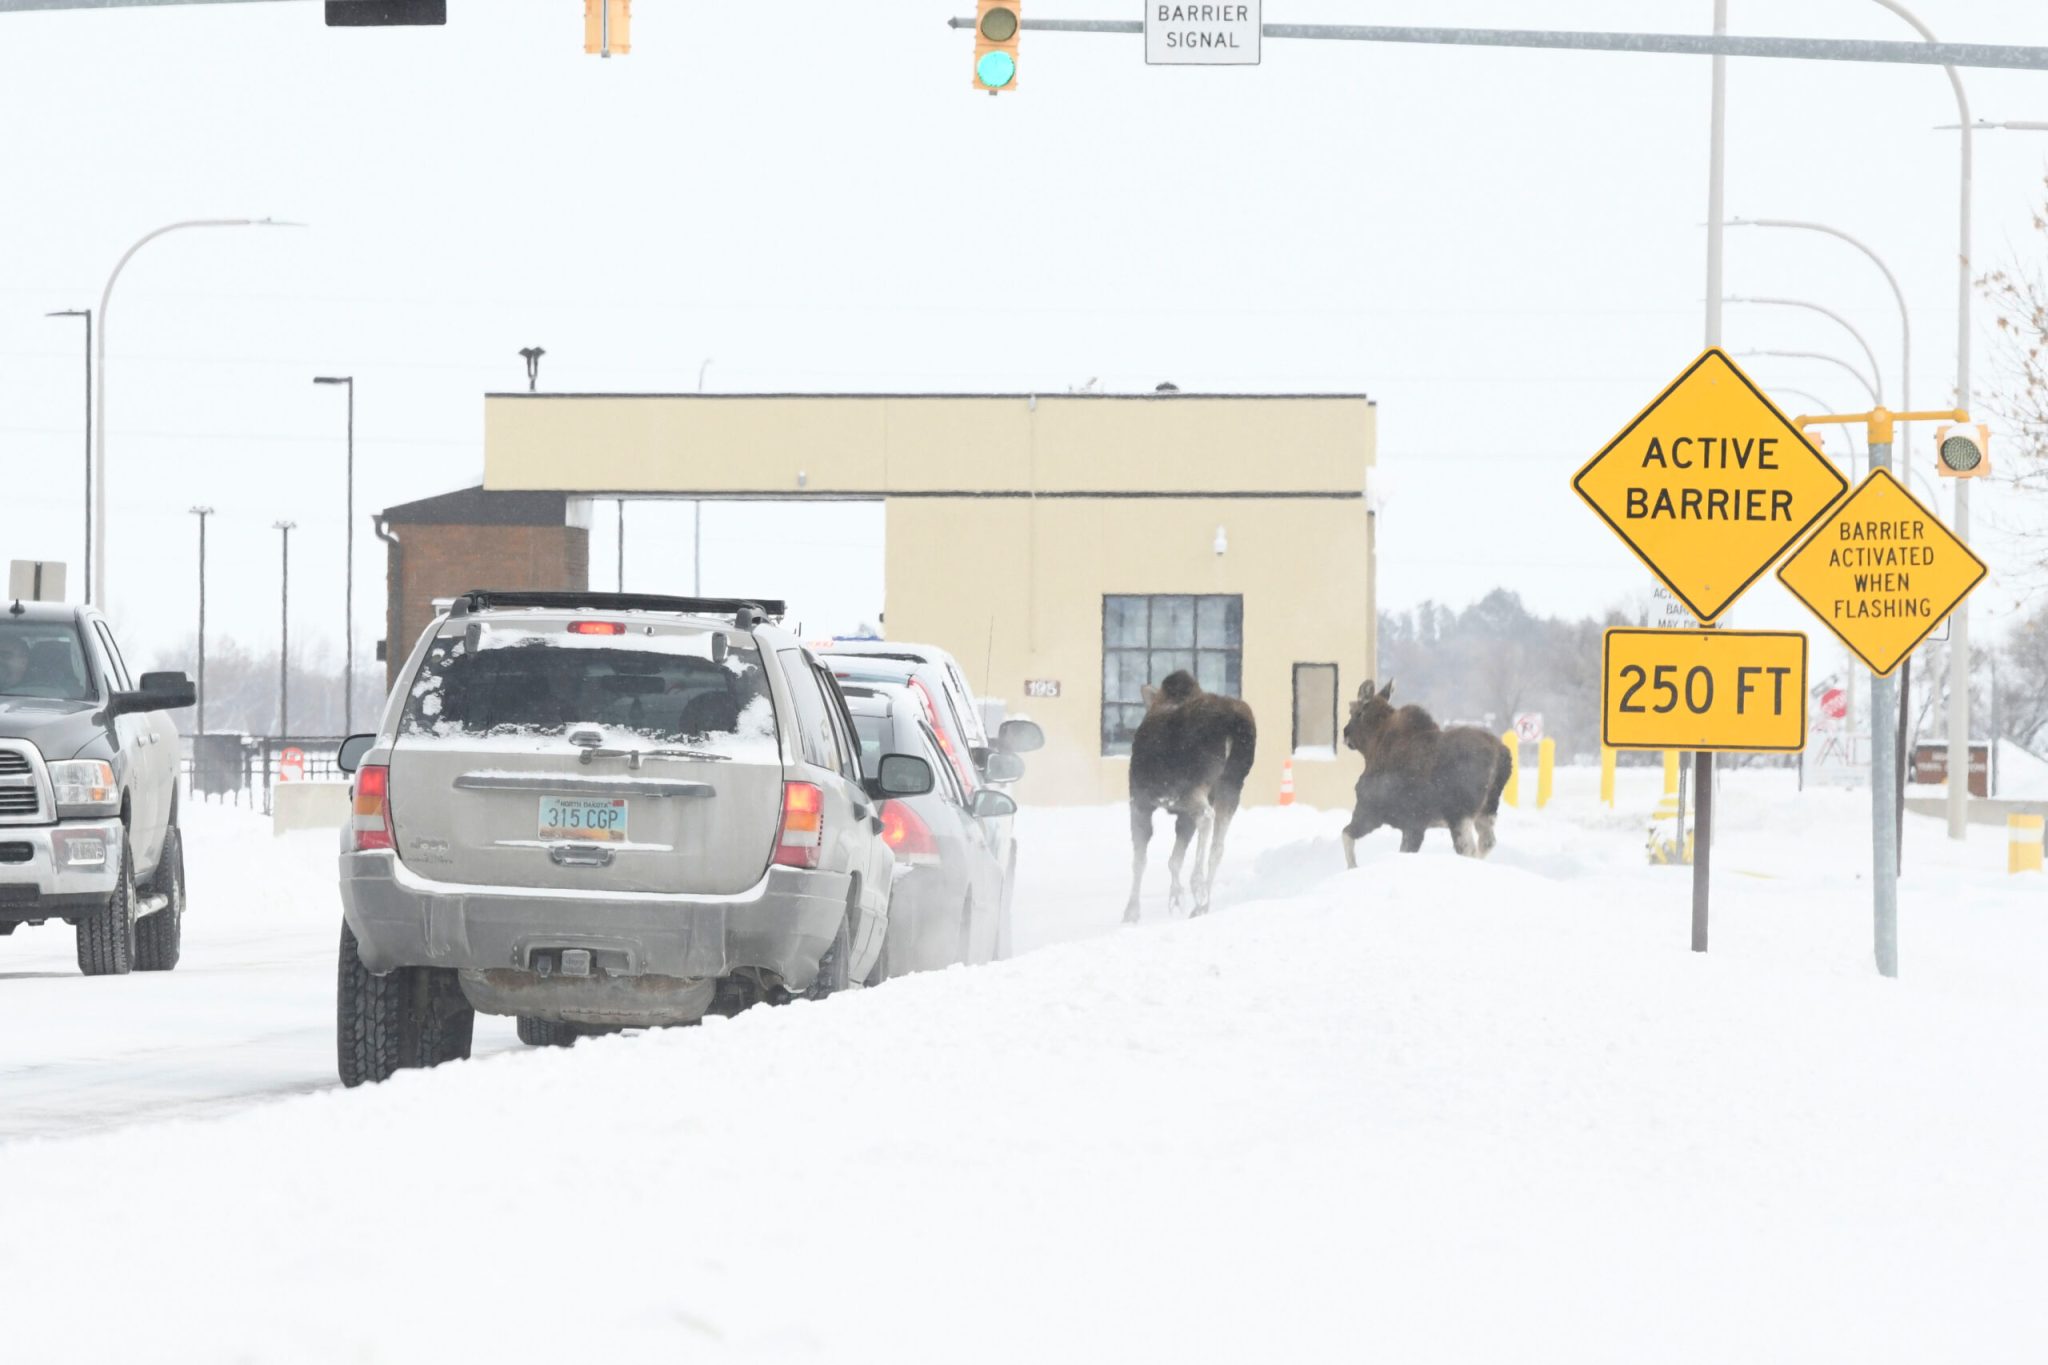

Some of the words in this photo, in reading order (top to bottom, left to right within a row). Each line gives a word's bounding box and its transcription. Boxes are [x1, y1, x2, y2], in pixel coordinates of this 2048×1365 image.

[1158, 5, 1248, 22] BARRIER
[1166, 31, 1240, 48] SIGNAL
[1641, 436, 1779, 470] ACTIVE
[1626, 487, 1793, 521] BARRIER
[1840, 520, 1924, 541] BARRIER
[1829, 546, 1934, 567] ACTIVATED
[1854, 572, 1909, 593] WHEN
[1834, 598, 1931, 619] FLASHING
[1619, 664, 1714, 715] 250
[1737, 666, 1791, 715] FT
[548, 807, 581, 828] 315
[586, 809, 619, 829] CGP
